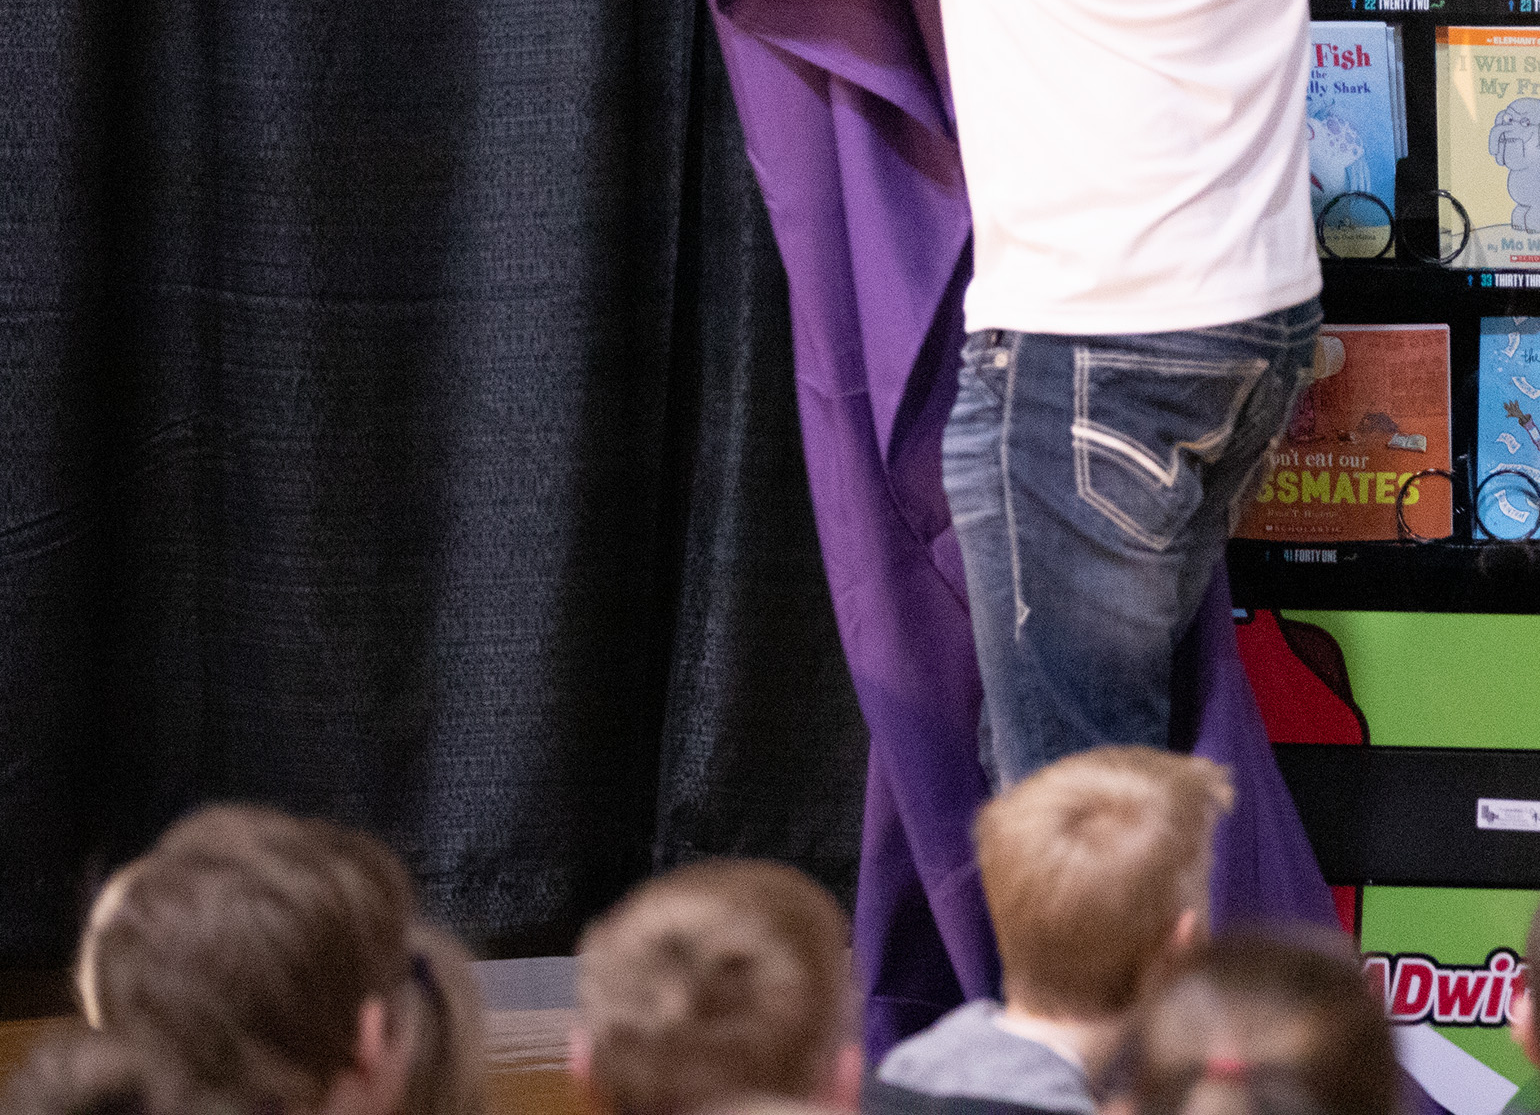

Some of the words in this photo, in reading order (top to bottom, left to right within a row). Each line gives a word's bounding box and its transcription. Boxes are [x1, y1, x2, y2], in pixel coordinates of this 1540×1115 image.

[1493, 37, 1536, 45] ELEPHANT
[1314, 42, 1371, 71] Fish
[1474, 55, 1517, 72] Will
[1311, 70, 1328, 79] the
[1333, 81, 1371, 94] Shark
[1479, 78, 1510, 98] My
[1501, 238, 1524, 251] Mo
[1481, 274, 1492, 286] 33
[1494, 273, 1524, 287] THIRTY
[1521, 347, 1540, 364] the
[1305, 452, 1334, 467] eat
[1339, 454, 1370, 469] our
[1294, 549, 1322, 563] FORTY
[1322, 550, 1338, 563] ONE
